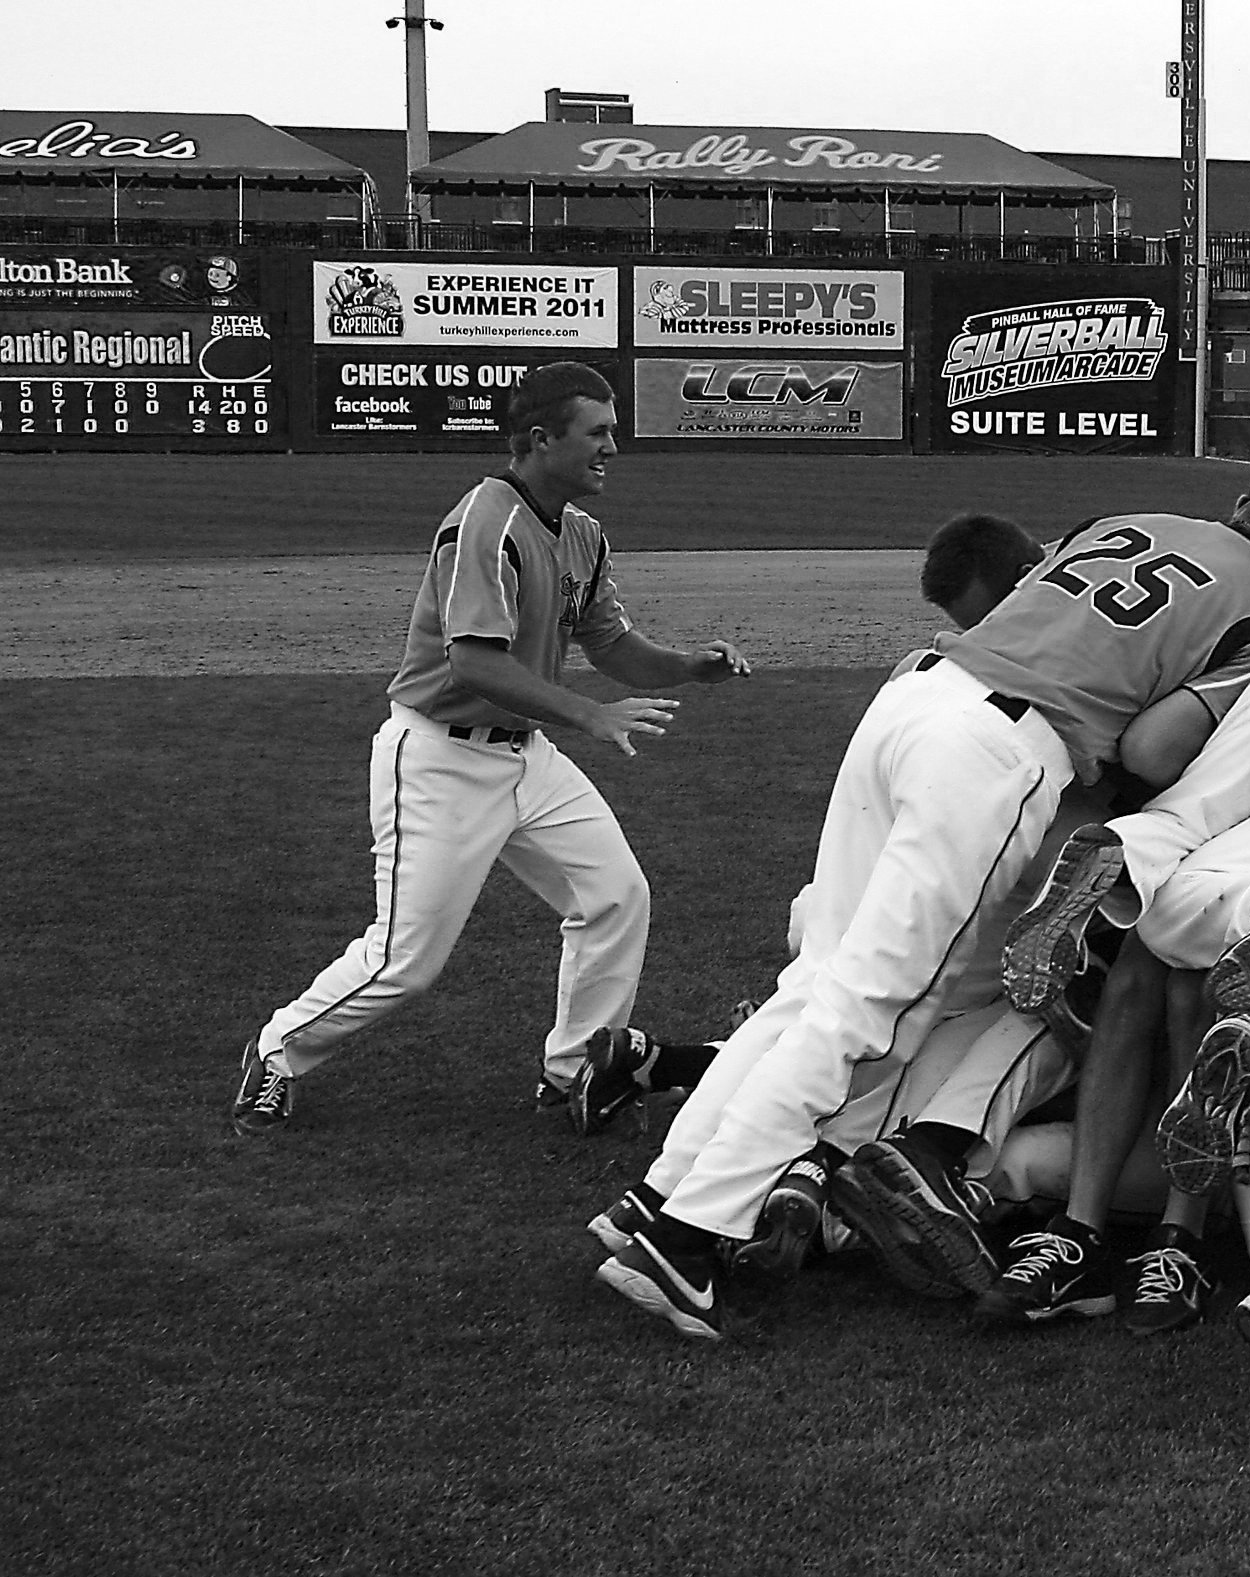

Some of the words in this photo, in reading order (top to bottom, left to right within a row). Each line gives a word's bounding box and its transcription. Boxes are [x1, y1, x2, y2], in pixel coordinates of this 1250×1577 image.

[1168, 61, 1180, 98] 300
[577, 135, 776, 174] Rally
[784, 135, 943, 172] Roni
[1182, 160, 1196, 341] UNIVERSITY
[56, 258, 133, 283] Bank
[17, 289, 26, 297] IS
[29, 289, 52, 297] JUST
[56, 289, 74, 298] THE
[427, 275, 567, 293] EXPERIENCE
[574, 278, 594, 293] IT
[413, 295, 537, 316] SUMMER
[546, 298, 605, 318] 2011
[680, 280, 876, 319] SLEEPY'S
[212, 316, 261, 327] PITCH
[333, 315, 399, 334] EXPERIENCE
[660, 318, 751, 334] Mattress
[758, 319, 896, 336] Professionals
[991, 312, 1041, 329] PINBALL
[1043, 308, 1073, 320] HALL
[1076, 305, 1092, 316] OF
[1094, 303, 1127, 315] FAME
[211, 325, 264, 337] SPEED
[439, 325, 579, 338] turkeyhillexperience.com
[0, 330, 68, 364] antic
[73, 330, 191, 368] Regional
[948, 315, 1165, 373] SILVERBALL
[341, 364, 428, 386] CHECK
[435, 365, 469, 387] US
[477, 366, 528, 388] OUT
[682, 364, 860, 405] LCM
[952, 360, 1051, 402] MUSEUM
[1056, 351, 1156, 382] ARCADE
[20, 382, 31, 397] 5
[52, 382, 63, 397] 6
[83, 382, 94, 397] 7
[115, 382, 126, 398] 8
[146, 383, 157, 398] 9
[193, 386, 205, 398] R
[222, 386, 236, 398] H
[253, 386, 266, 398] E
[20, 400, 34, 414] 0
[51, 400, 66, 414] 7
[87, 400, 93, 414] 1
[114, 400, 128, 414] 0
[146, 400, 159, 414] 0
[188, 401, 212, 414] 14
[220, 401, 247, 414] 20
[254, 401, 268, 414] 0
[335, 395, 411, 413] facebook
[21, 419, 35, 433] 2
[56, 419, 63, 433] 1
[84, 419, 97, 433] 0
[115, 419, 129, 433] 0
[192, 420, 206, 433] 3
[227, 420, 241, 433] 8
[254, 420, 268, 433] 0
[368, 423, 418, 431] Barnstormers
[677, 424, 755, 433] LANCASTER
[757, 424, 807, 433] COUNTY
[810, 424, 860, 433] MOTORS
[950, 411, 1045, 435] SUITE
[1058, 412, 1157, 436] LEVEL
[1040, 526, 1214, 630] 25
